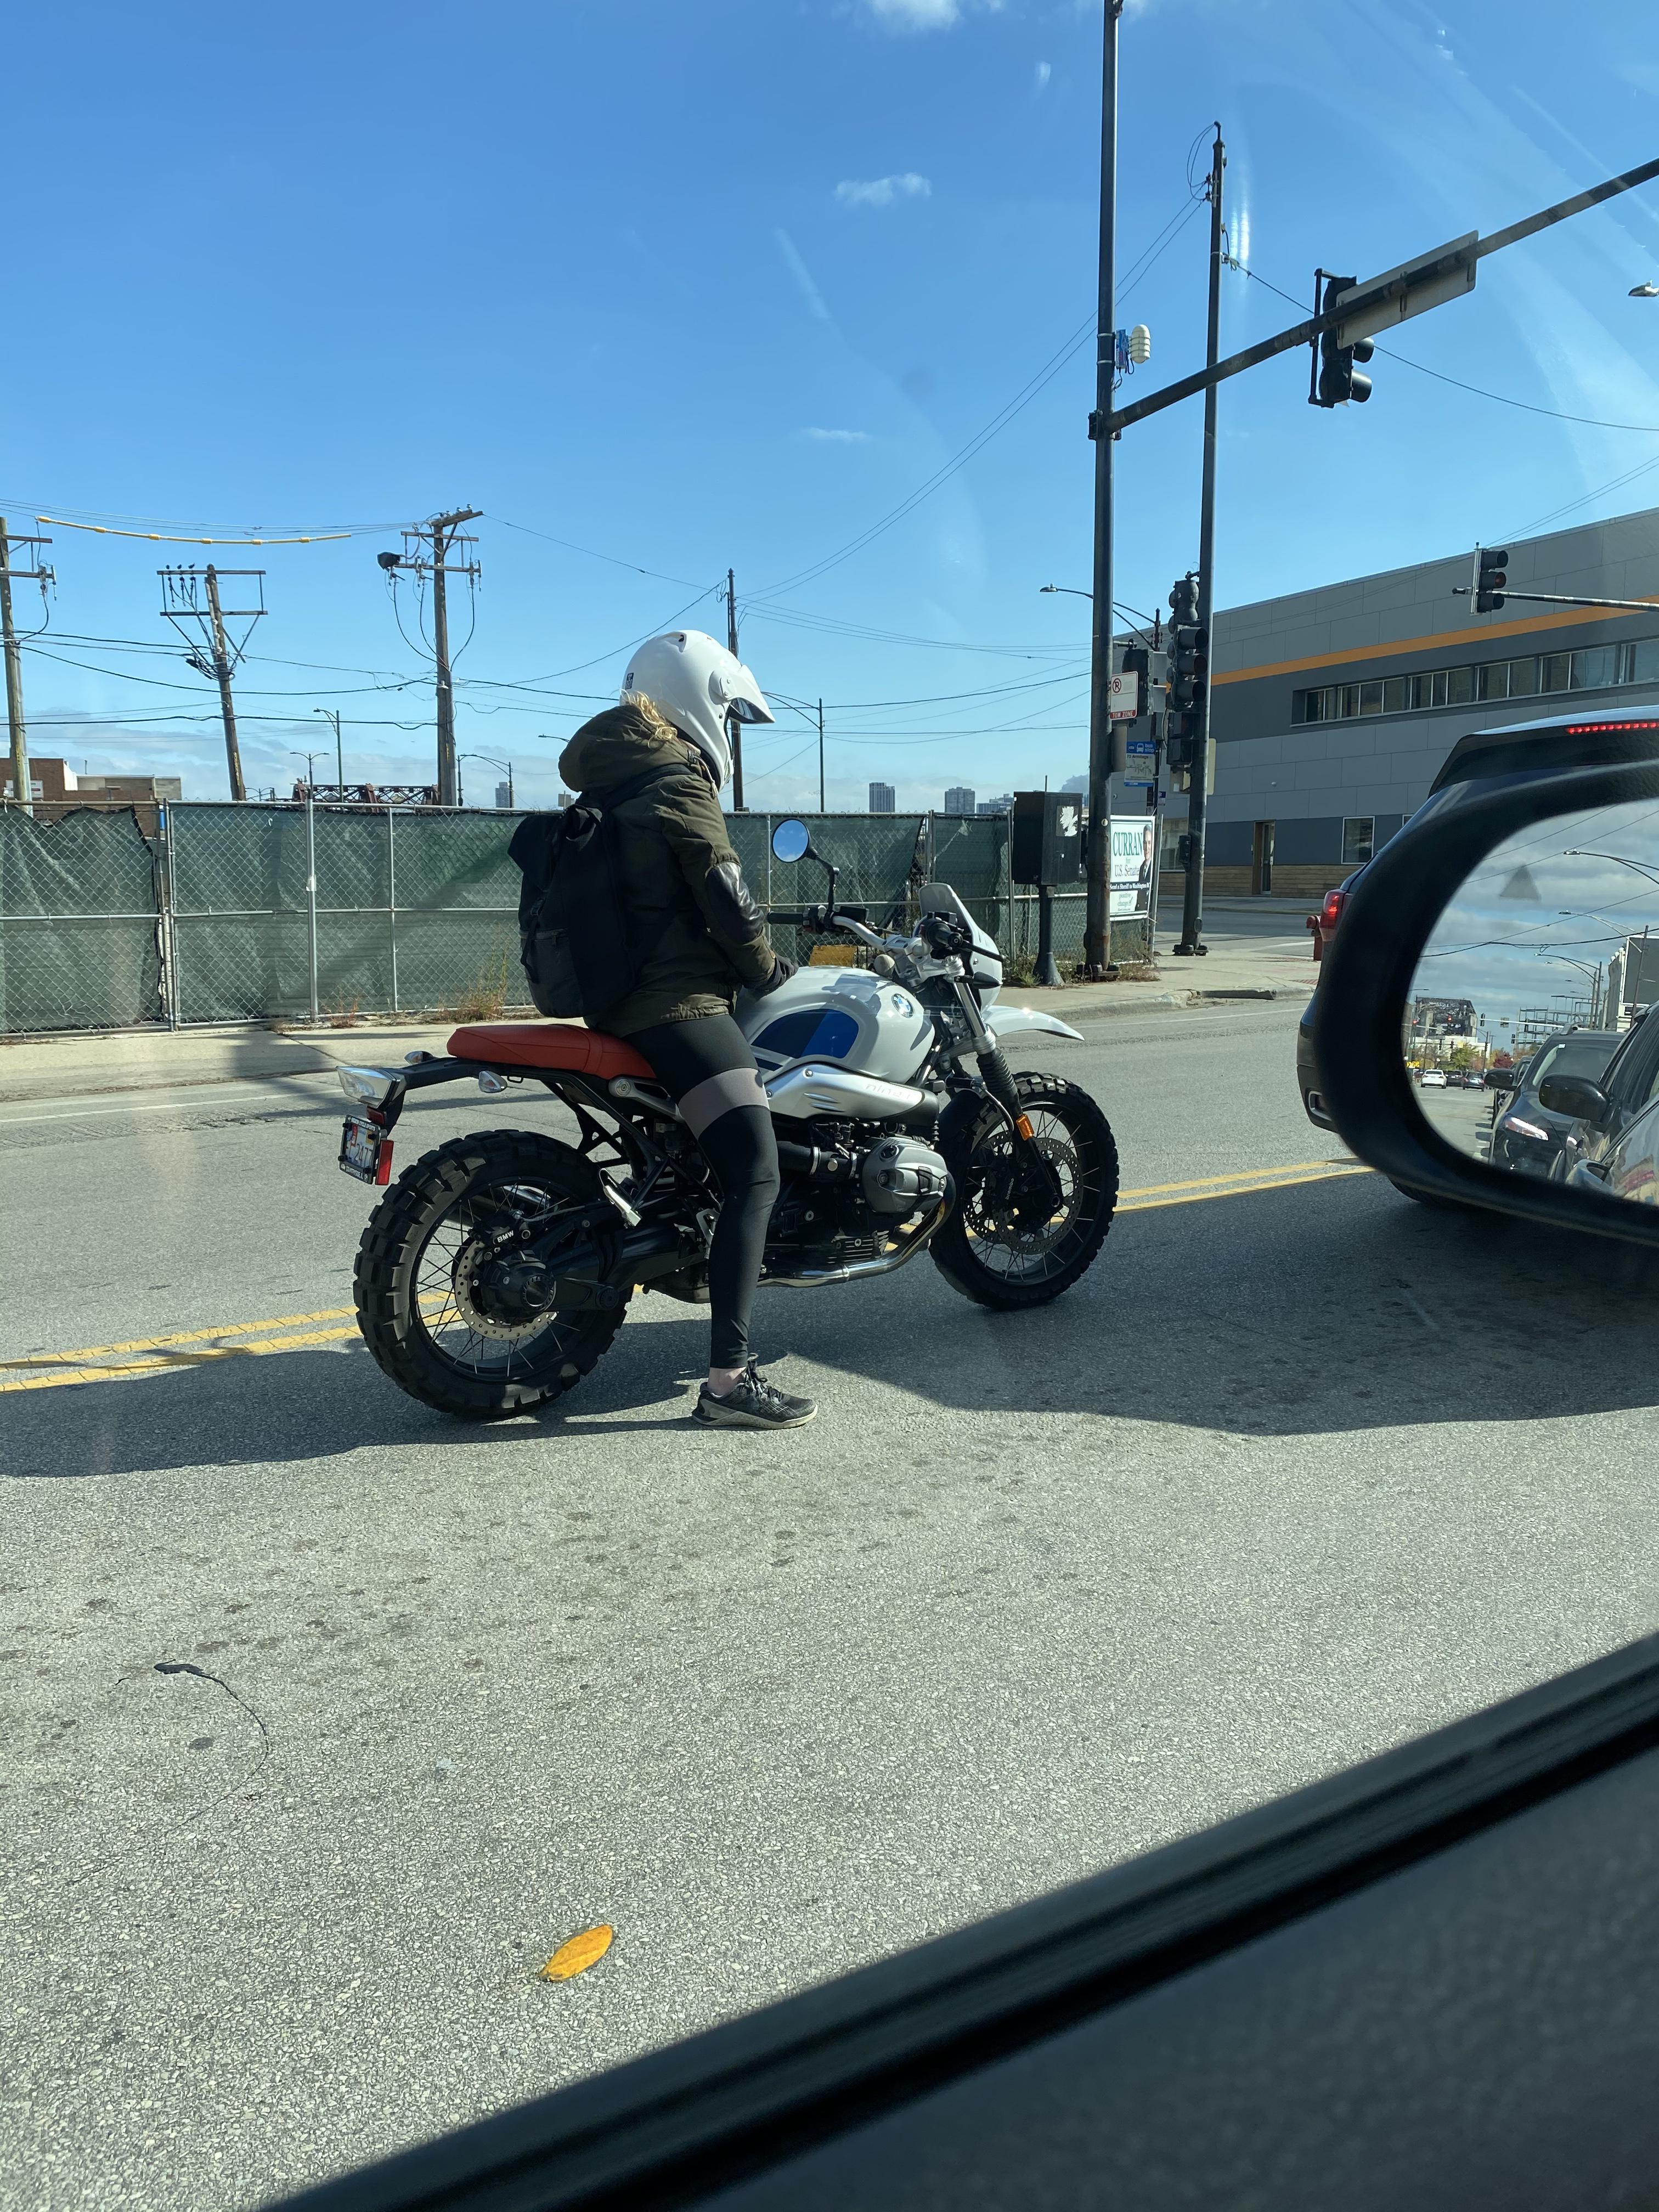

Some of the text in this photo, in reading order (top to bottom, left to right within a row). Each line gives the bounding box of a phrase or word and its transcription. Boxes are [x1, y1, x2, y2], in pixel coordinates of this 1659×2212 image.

[1113, 832, 1143, 856] CURRAN
[1115, 864, 1139, 877] U.S. Senate
[1005, 1178, 1014, 1200] brembo
[497, 1230, 514, 1243] BMW
